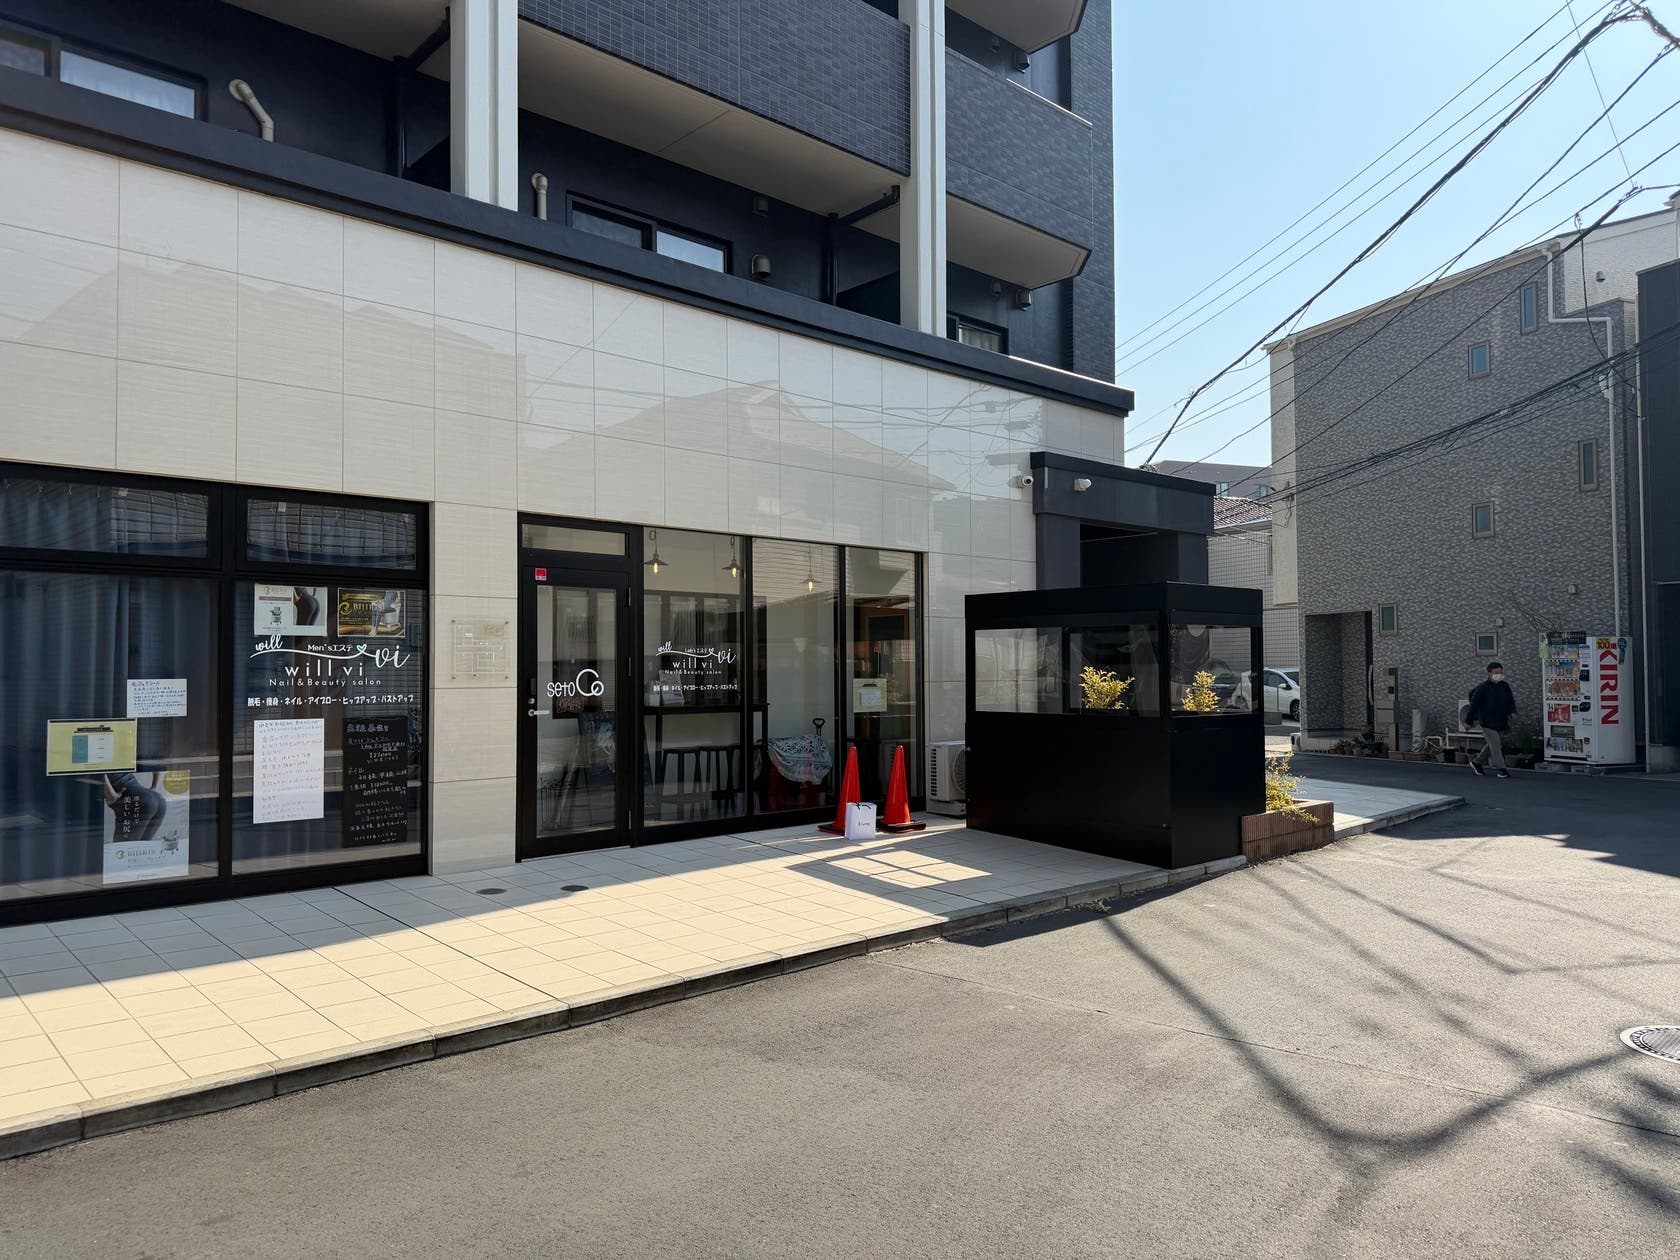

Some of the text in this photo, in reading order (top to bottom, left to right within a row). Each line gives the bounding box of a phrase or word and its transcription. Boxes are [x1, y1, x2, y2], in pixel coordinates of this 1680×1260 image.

[255, 634, 284, 652] will
[374, 645, 410, 669] vi
[672, 657, 713, 669] will vi
[285, 659, 364, 677] will vi
[352, 678, 382, 686] salon
[1599, 643, 1619, 725] KIRIN
